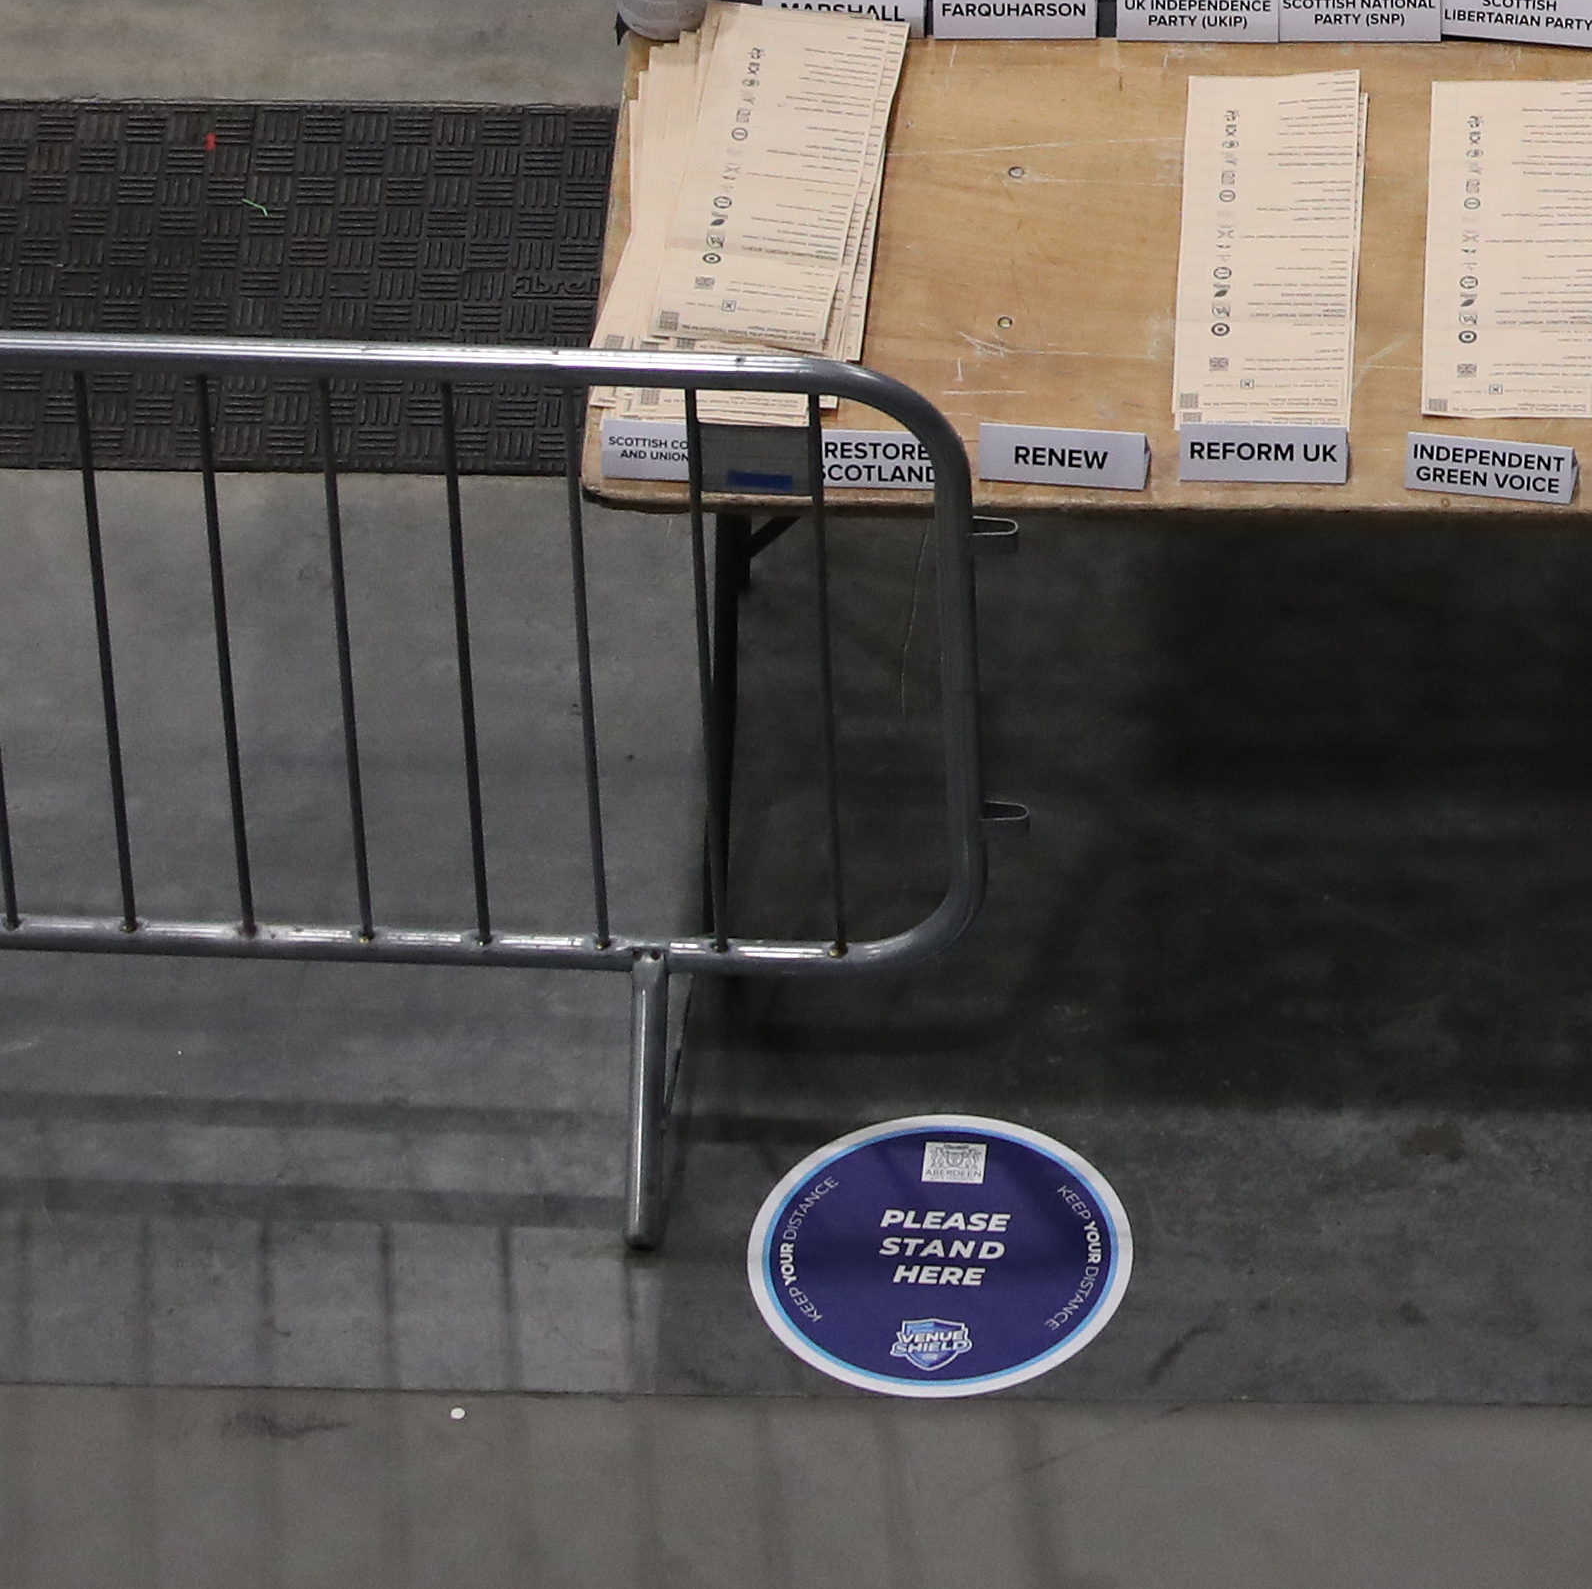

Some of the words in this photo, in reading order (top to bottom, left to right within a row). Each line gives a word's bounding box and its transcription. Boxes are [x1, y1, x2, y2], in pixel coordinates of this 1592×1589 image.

[942, 2, 1086, 17] FARQUHARSON
[1124, 0, 1146, 10] UK
[1151, 0, 1271, 12] INDEPENDENCE
[1148, 15, 1197, 27] PARTY
[1202, 15, 1247, 30] (UKIP)
[1314, 13, 1362, 25] PARTY
[1366, 13, 1405, 27] (SNP)
[1444, 9, 1541, 27] LIBERTARIAN
[1545, 16, 1592, 32] PARTY
[609, 436, 668, 448] SCOTTISH
[824, 442, 931, 460] RESTORE
[1190, 442, 1294, 461] REFORM
[1303, 444, 1337, 463] UK
[620, 450, 647, 459] AND
[650, 451, 689, 461] UNION
[1014, 445, 1109, 470] RENEW
[1413, 443, 1565, 473] INDEPENDENT
[1416, 466, 1487, 486] GREEN
[1494, 473, 1560, 494] VOICE
[783, 1176, 839, 1241] DISTANCE
[1057, 1184, 1091, 1220] KEEP
[880, 1209, 1011, 1232] PLEASE
[878, 1238, 1005, 1260] STAND
[1083, 1220, 1102, 1264] YOUR
[780, 1243, 798, 1286] YOUR
[892, 1264, 985, 1286] HERE
[789, 1287, 822, 1322] KEEP
[1045, 1264, 1099, 1331] DISTANCE
[895, 1340, 969, 1354] SHIELD
[901, 1331, 964, 1343] VENUE
